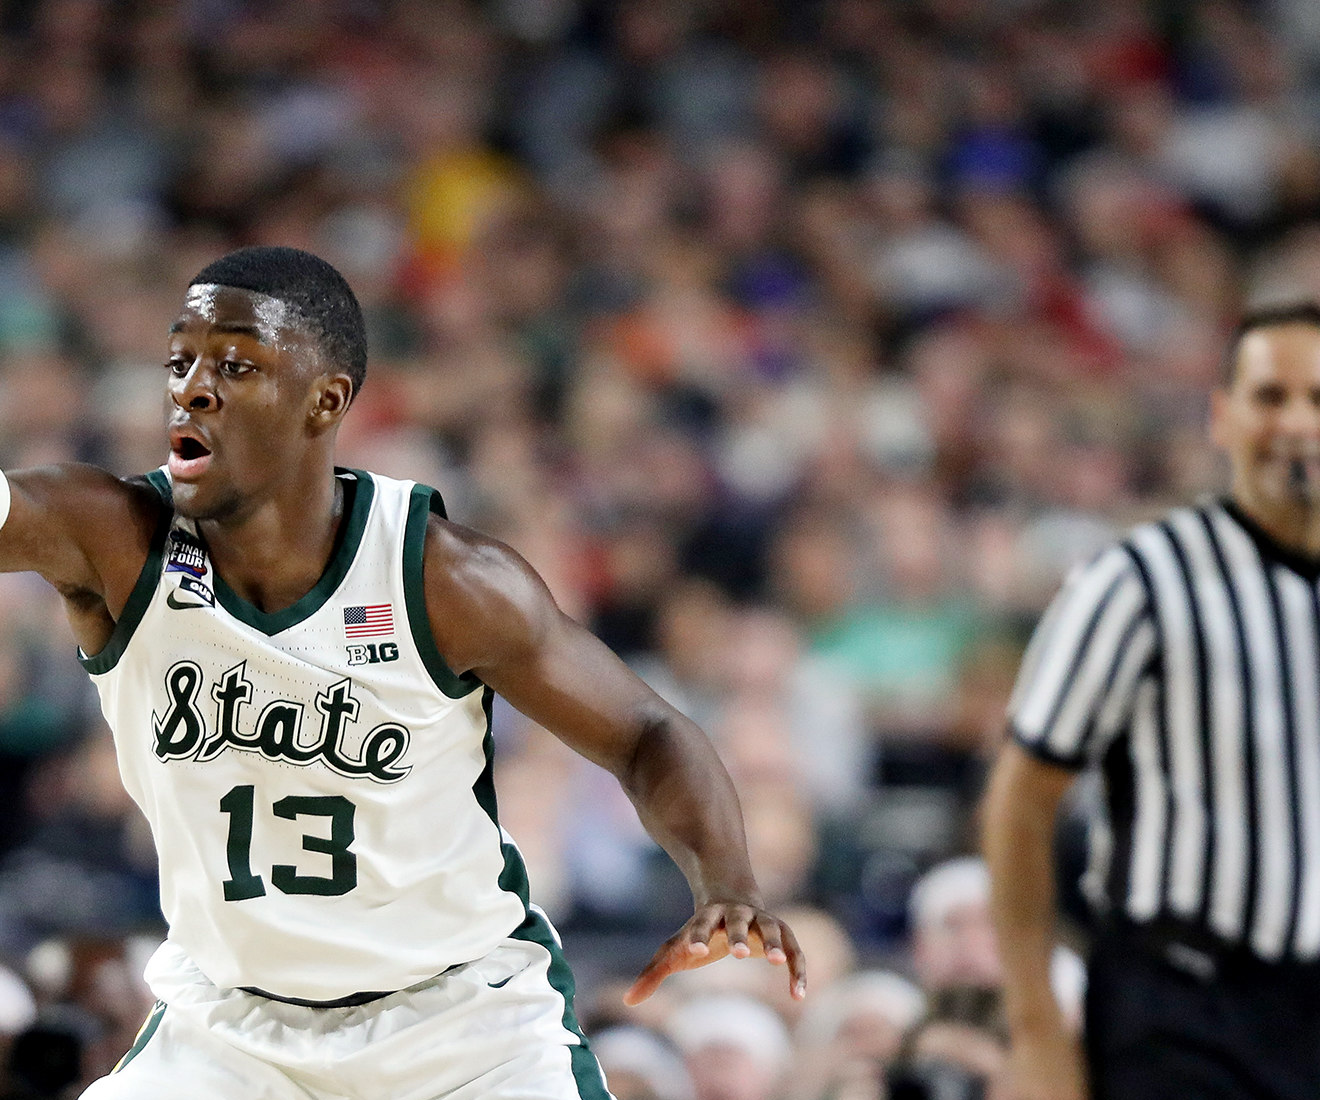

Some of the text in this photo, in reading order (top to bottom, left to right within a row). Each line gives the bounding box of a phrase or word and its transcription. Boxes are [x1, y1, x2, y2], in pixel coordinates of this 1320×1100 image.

[169, 551, 204, 569] FOUR
[173, 541, 204, 559] FINAL
[152, 659, 414, 785] State
[219, 784, 358, 902] 13
